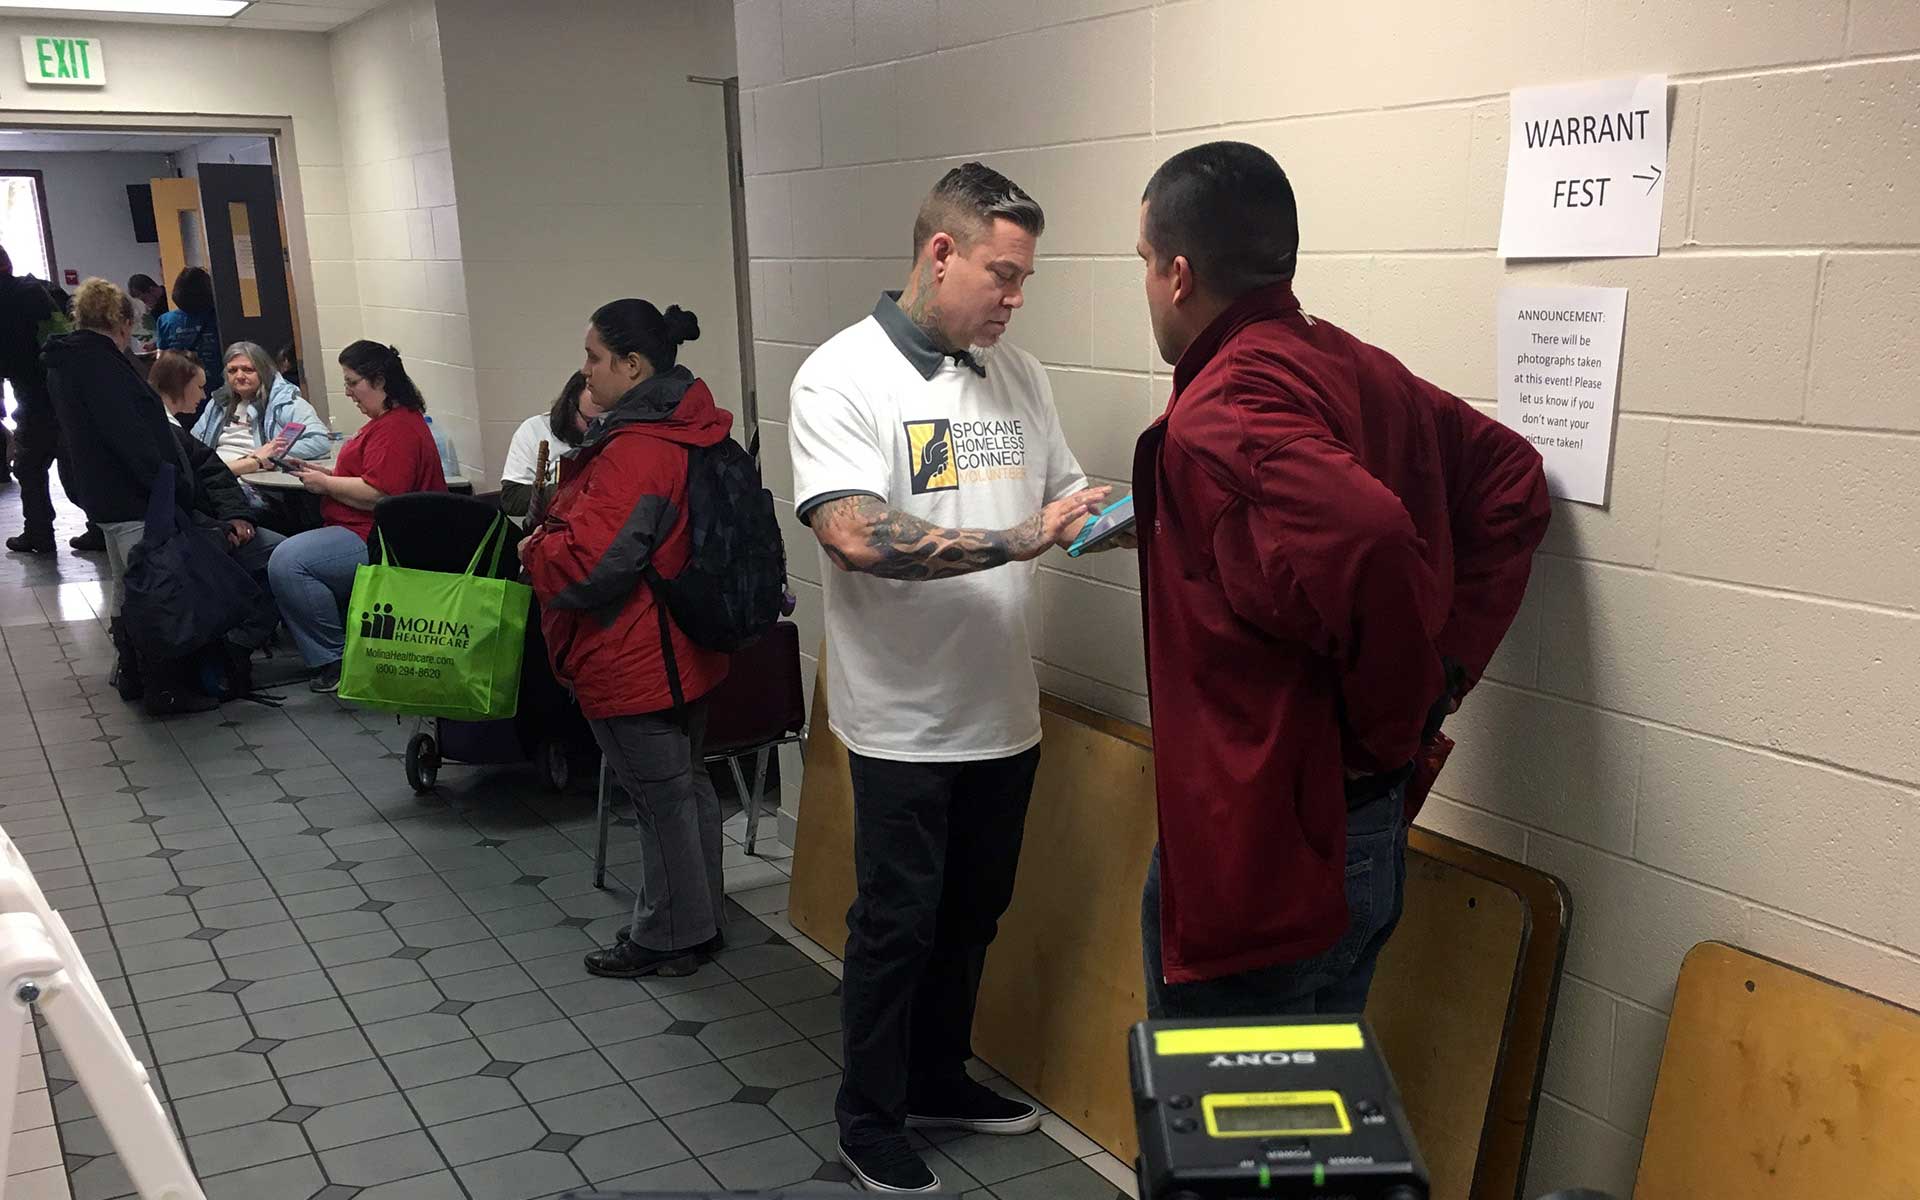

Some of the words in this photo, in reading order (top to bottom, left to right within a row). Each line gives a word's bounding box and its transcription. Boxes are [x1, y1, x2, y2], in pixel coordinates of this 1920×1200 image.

[36, 38, 90, 79] EXIT
[1525, 110, 1650, 148] WARRANT
[1553, 178, 1611, 208] FEST
[1518, 310, 1606, 322] ANNOUNCEMENT:
[1531, 333, 1559, 344] There
[1562, 334, 1577, 345] will
[1580, 335, 1591, 346] be
[1517, 353, 1575, 367] photographs
[1578, 356, 1602, 368] taken
[1514, 374, 1523, 383] at
[1526, 373, 1542, 384] this
[1545, 376, 1573, 387] event!
[1575, 376, 1602, 389] Please
[1519, 393, 1531, 404] let
[1534, 396, 1544, 405] us
[1546, 395, 1569, 407] know
[1571, 396, 1578, 408] if
[1579, 400, 1594, 410] you
[952, 420, 1023, 439] SPOKANE
[1547, 418, 1567, 428] want
[1570, 420, 1590, 430] your
[955, 436, 1024, 453] HOMELESS
[1557, 438, 1583, 450] taken!
[957, 451, 1025, 470] CONNECT
[959, 467, 1026, 483] VOLUNTEE
[397, 616, 470, 639] MOLINA
[395, 633, 470, 649] HEALTHCARE
[365, 648, 454, 666] MolinaHealthcare.com
[376, 663, 396, 676] (800)
[398, 666, 441, 680] 294-8620
[1208, 1051, 1317, 1067] SONY
